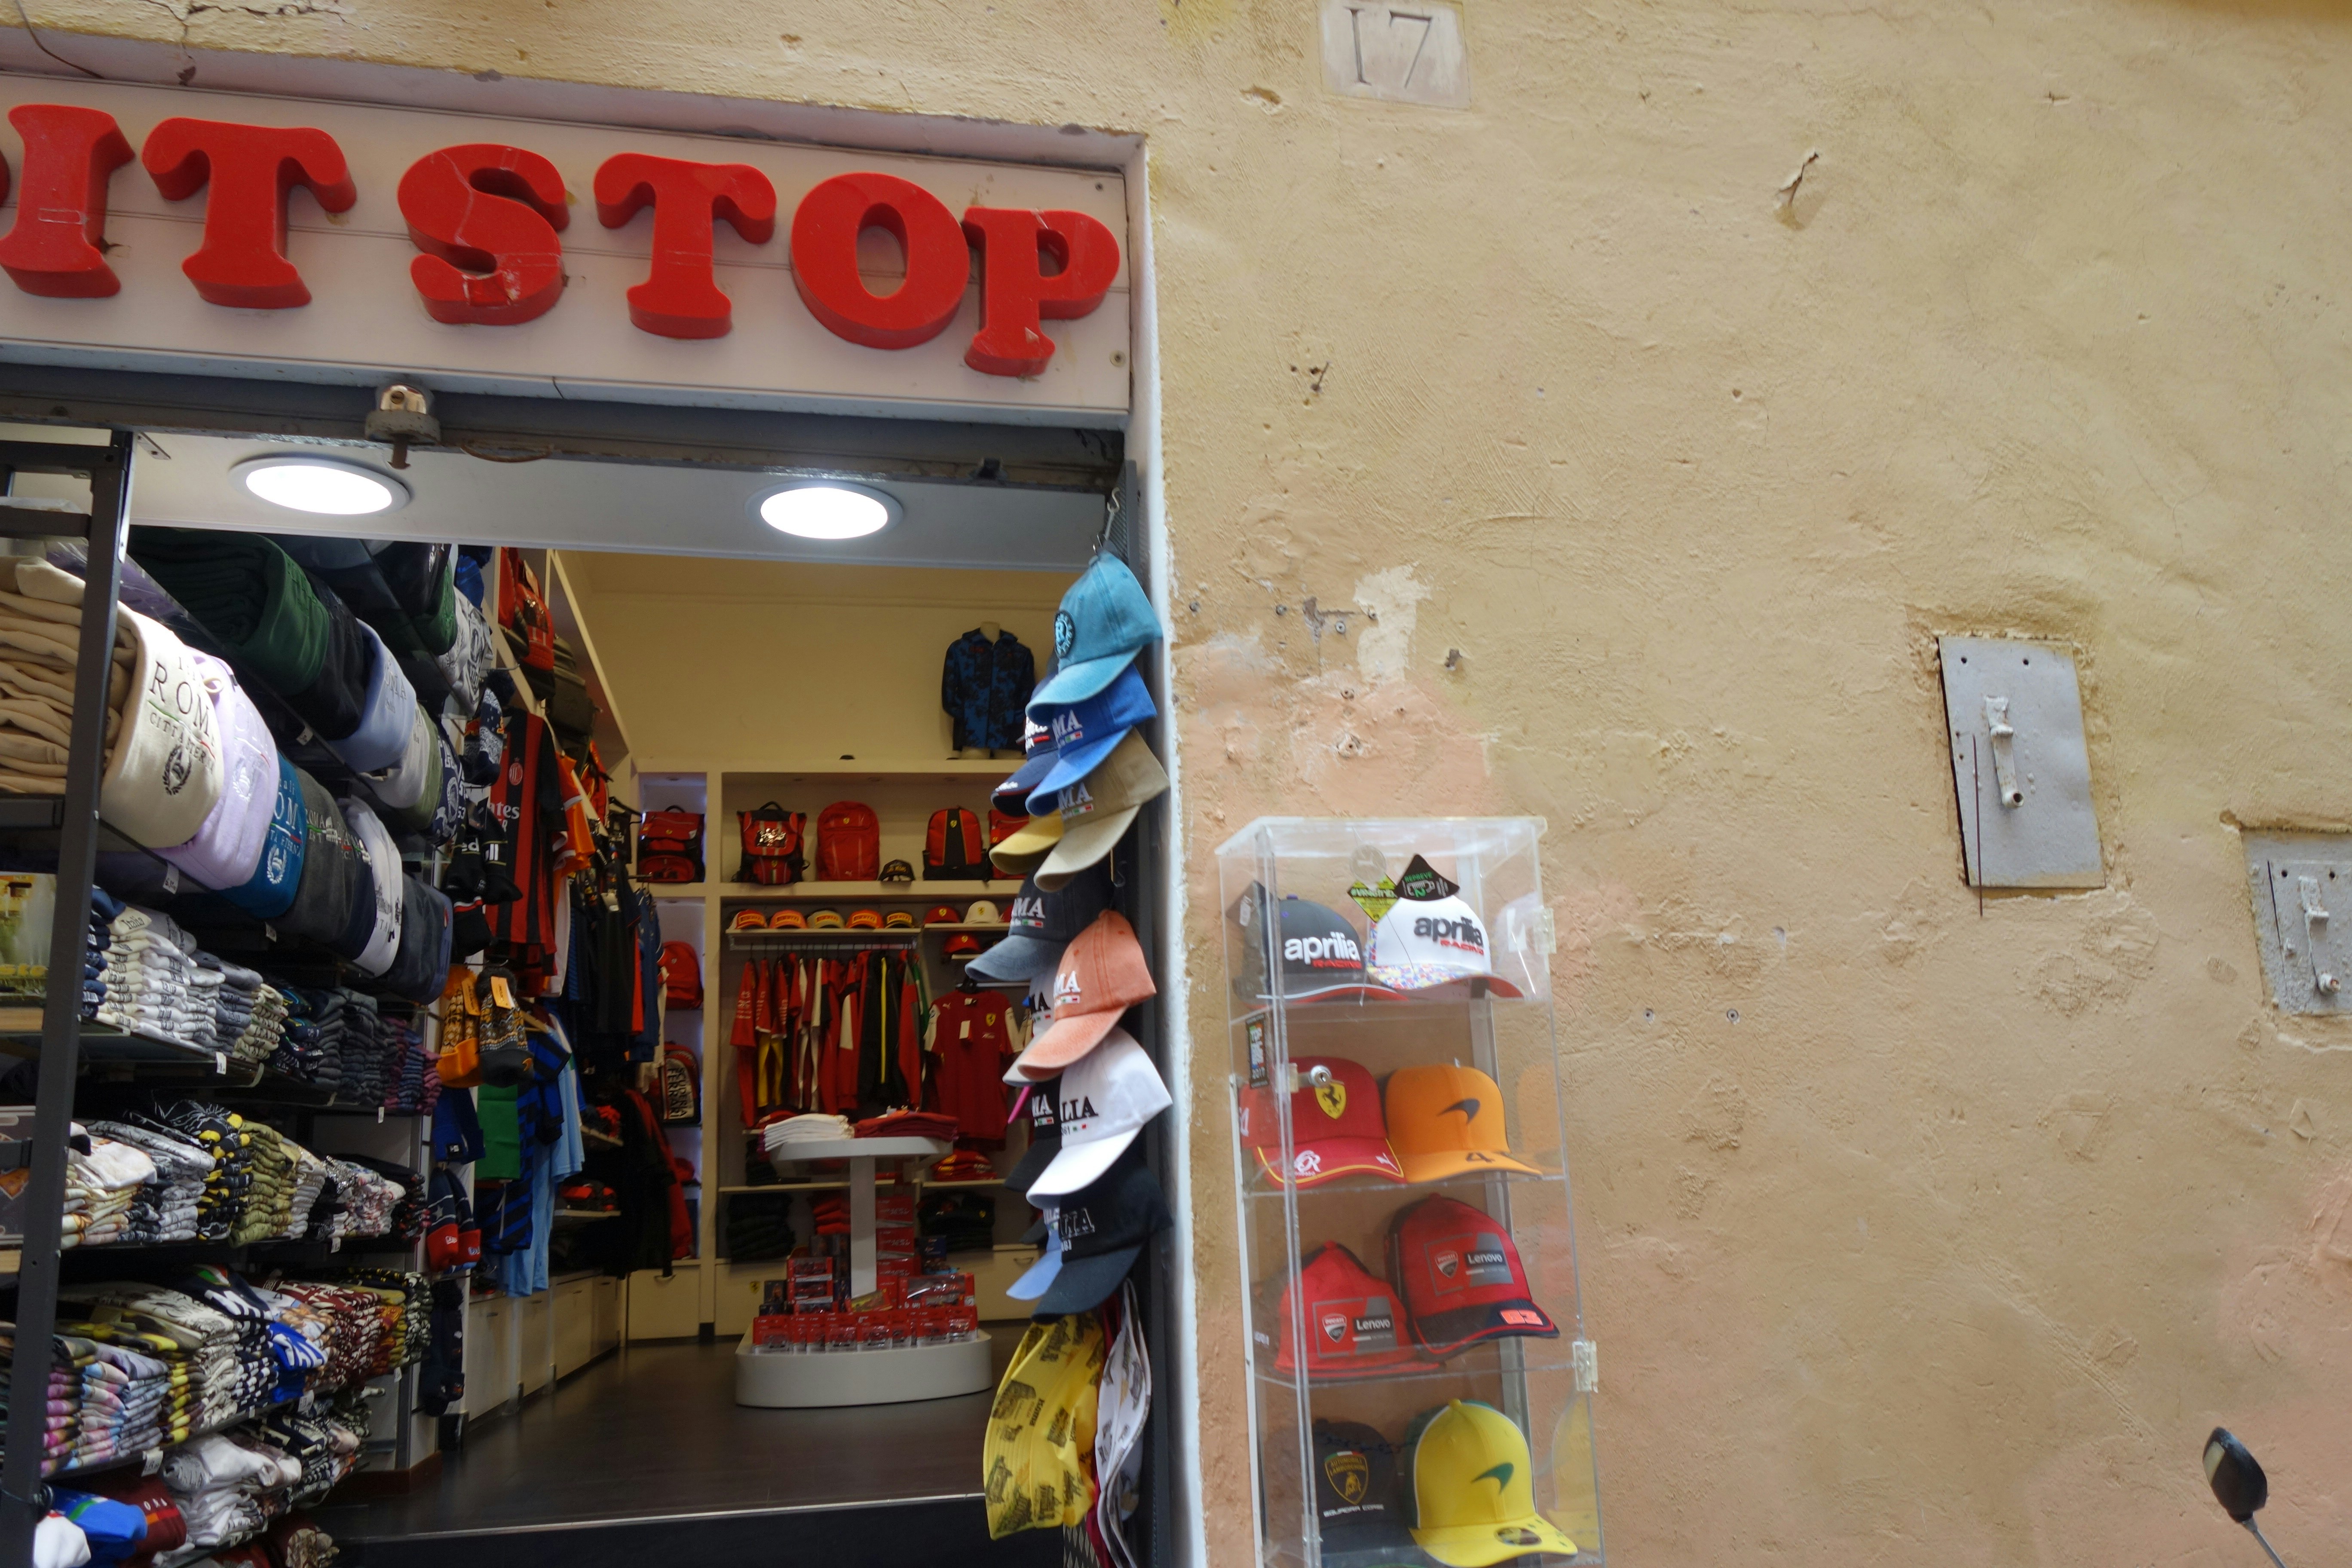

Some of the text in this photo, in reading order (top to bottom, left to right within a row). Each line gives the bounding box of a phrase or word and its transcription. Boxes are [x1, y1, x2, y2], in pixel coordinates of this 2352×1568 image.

[0, 104, 1121, 377] IT STOP
[1414, 916, 1483, 946] aprilia
[1284, 931, 1361, 965] aprilia
[1467, 1253, 1503, 1265] Lenovo
[1356, 1318, 1391, 1331] Lenovo
